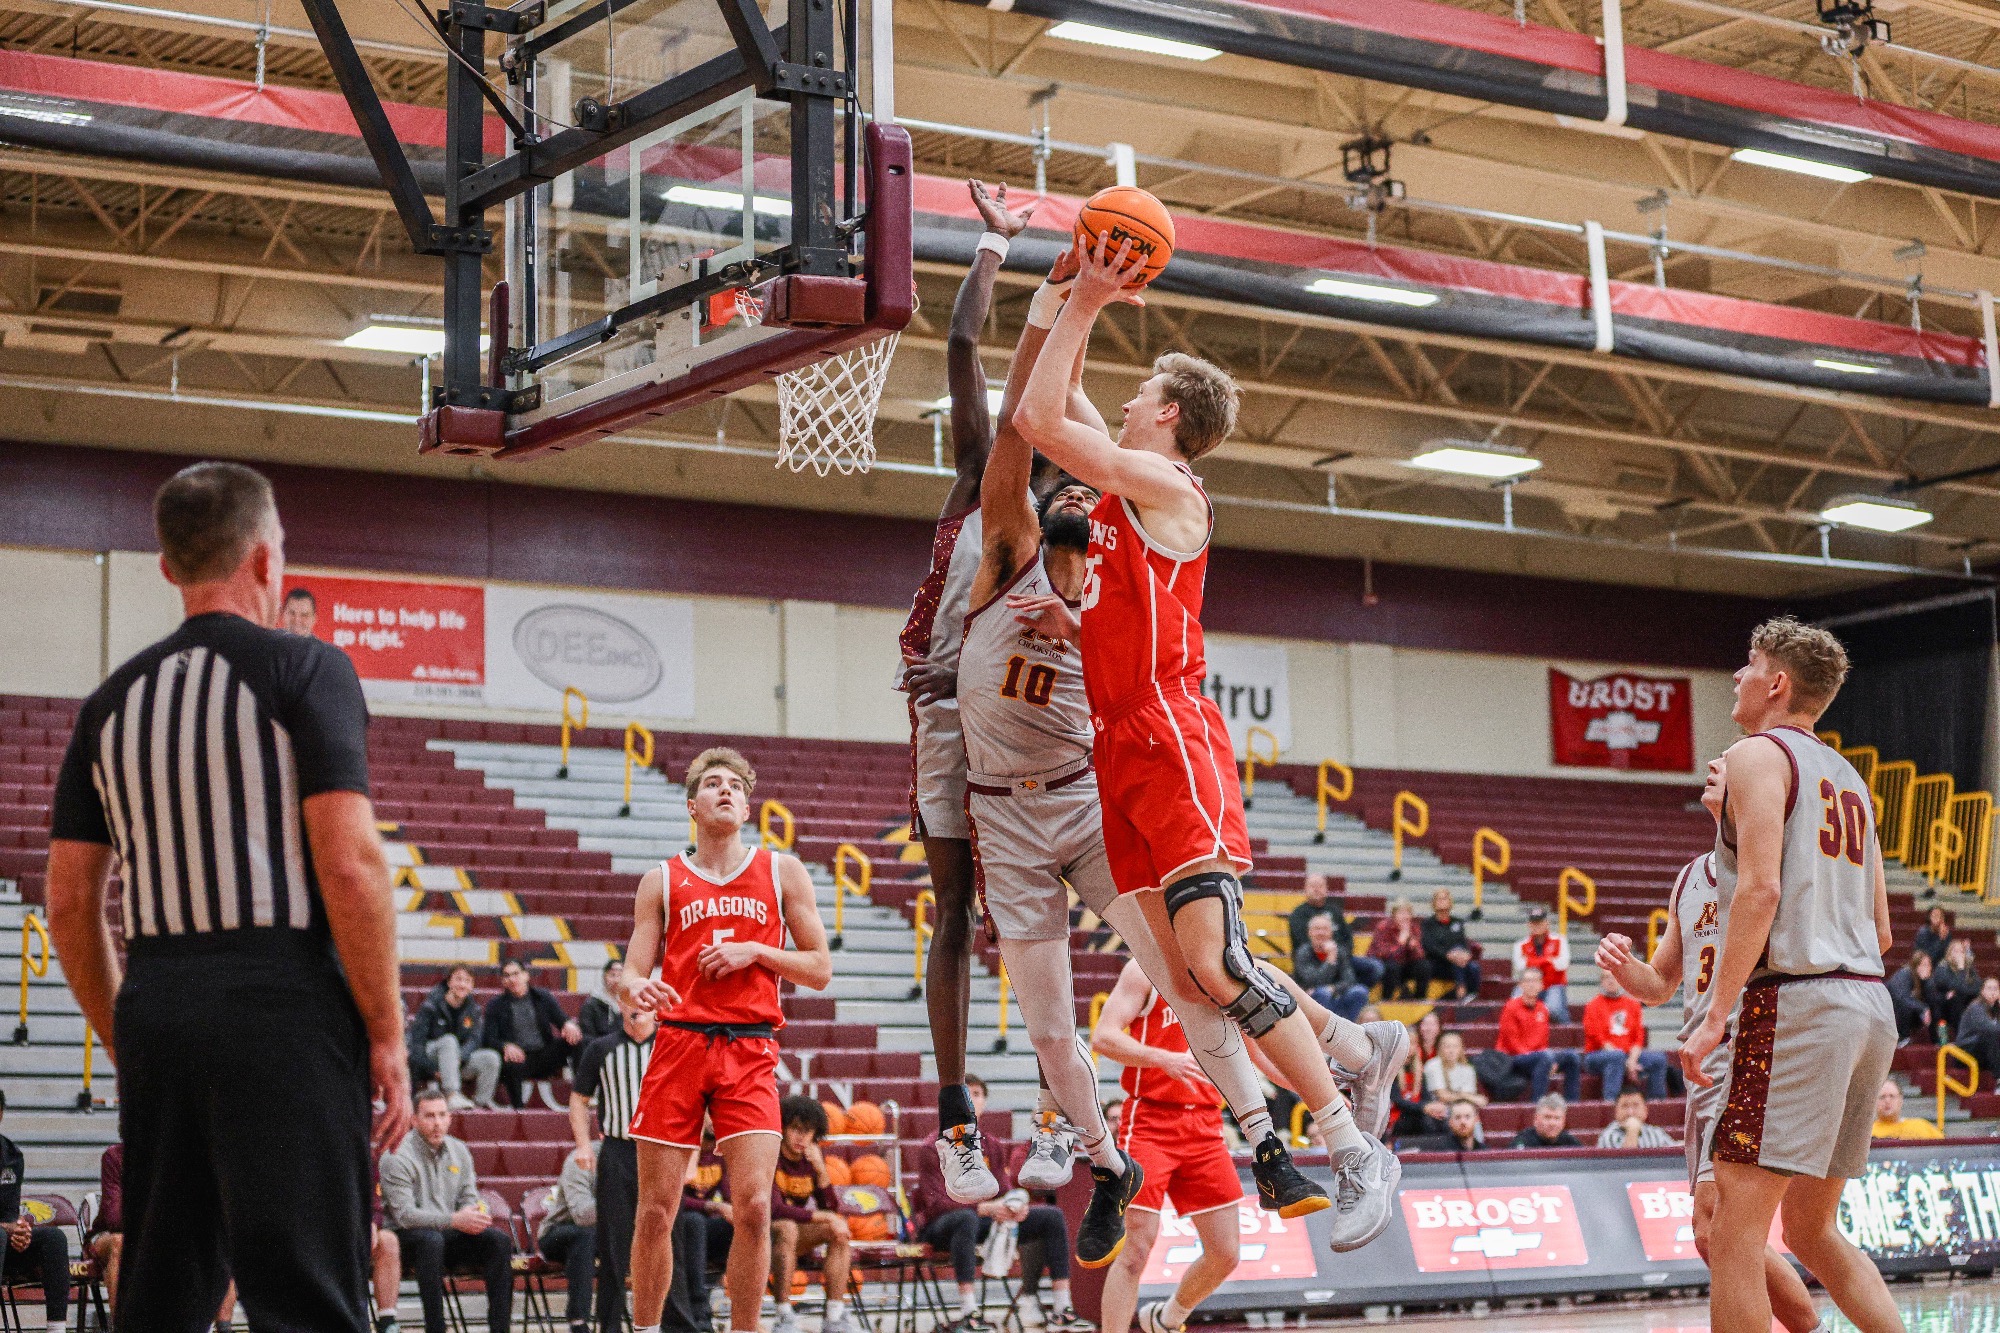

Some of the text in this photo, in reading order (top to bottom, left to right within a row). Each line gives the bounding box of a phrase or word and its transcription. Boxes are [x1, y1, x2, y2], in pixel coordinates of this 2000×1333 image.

[333, 602, 467, 631] Here to help life
[333, 629, 356, 648] go
[1018, 638, 1064, 661] CROOKSTON
[1000, 654, 1059, 707] 10
[1568, 678, 1677, 713] BROST
[1819, 777, 1867, 868] 30
[679, 896, 769, 932] DRAGONS
[1696, 943, 1717, 995] 3
[1412, 1195, 1563, 1229] BROST
[1638, 1190, 1694, 1219] BR
[1836, 1172, 1912, 1249] OME
[1907, 1171, 1954, 1246] OF
